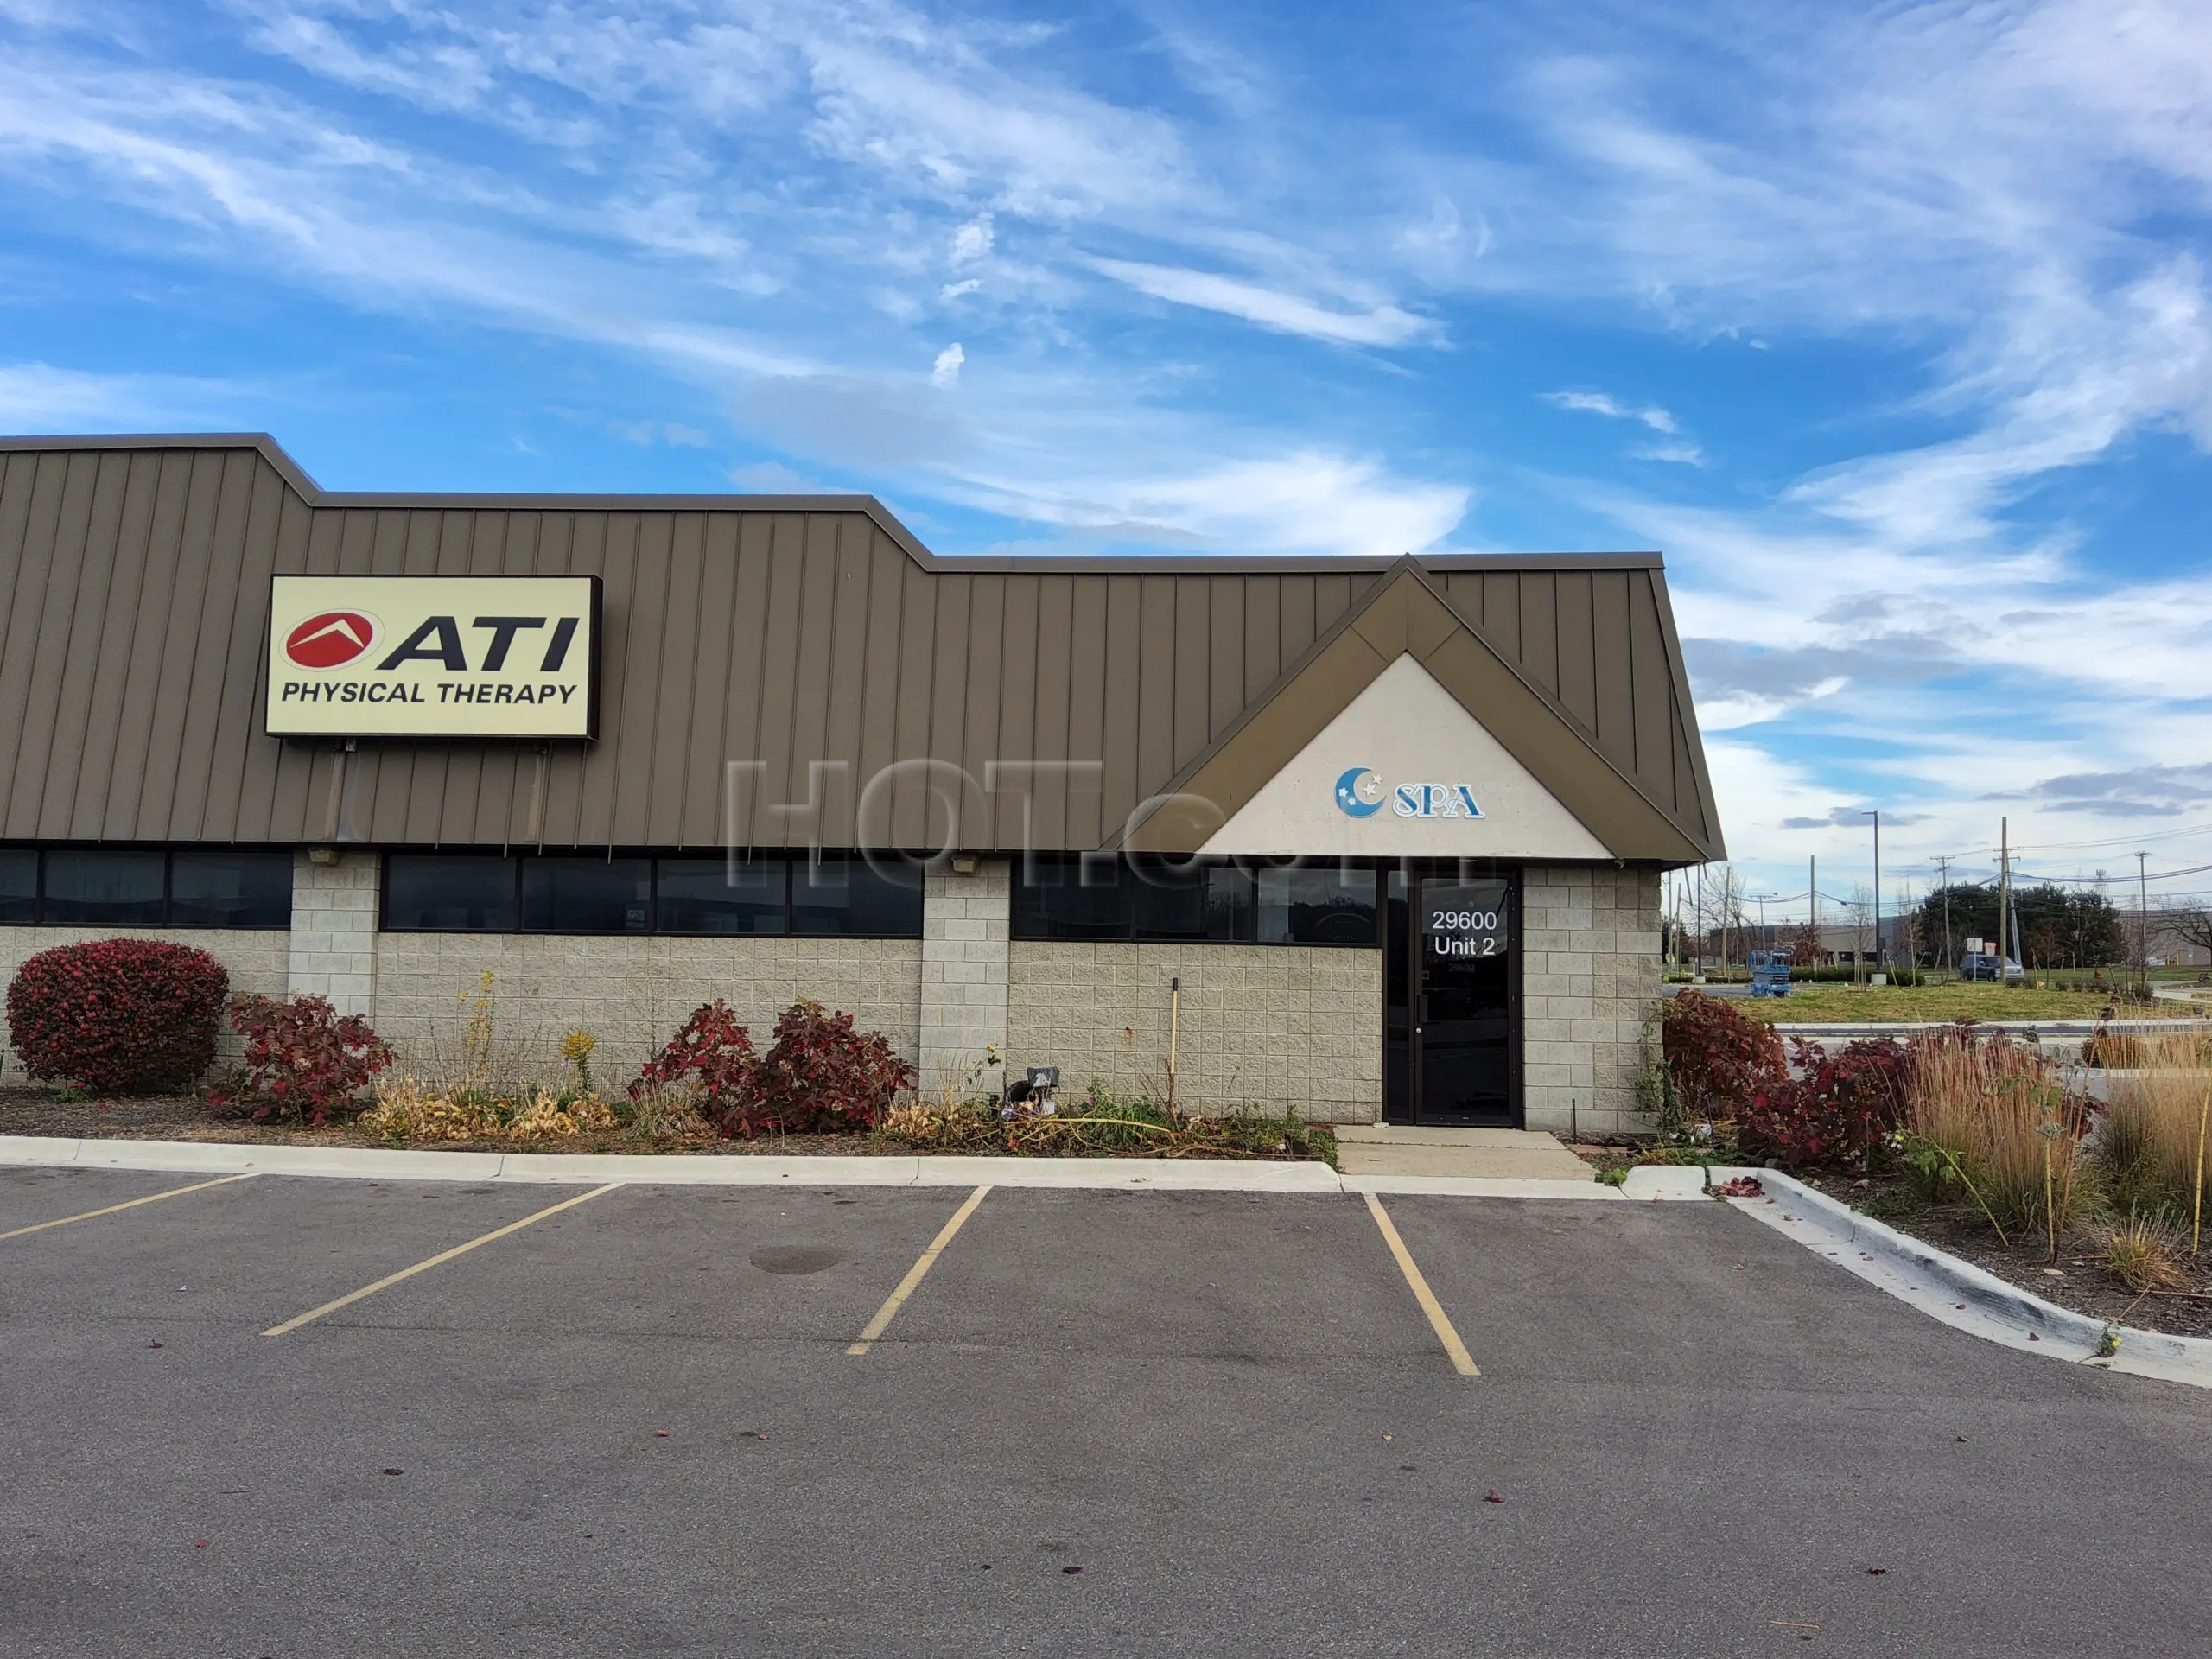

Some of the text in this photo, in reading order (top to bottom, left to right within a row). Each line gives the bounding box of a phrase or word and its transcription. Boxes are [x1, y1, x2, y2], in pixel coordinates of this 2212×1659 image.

[375, 616, 580, 671] ATI
[282, 682, 578, 704] PHYSICAL THERAPY
[1392, 783, 1485, 819] SPA
[1432, 912, 1497, 930] 29600
[1434, 936, 1496, 956] Unit 2
